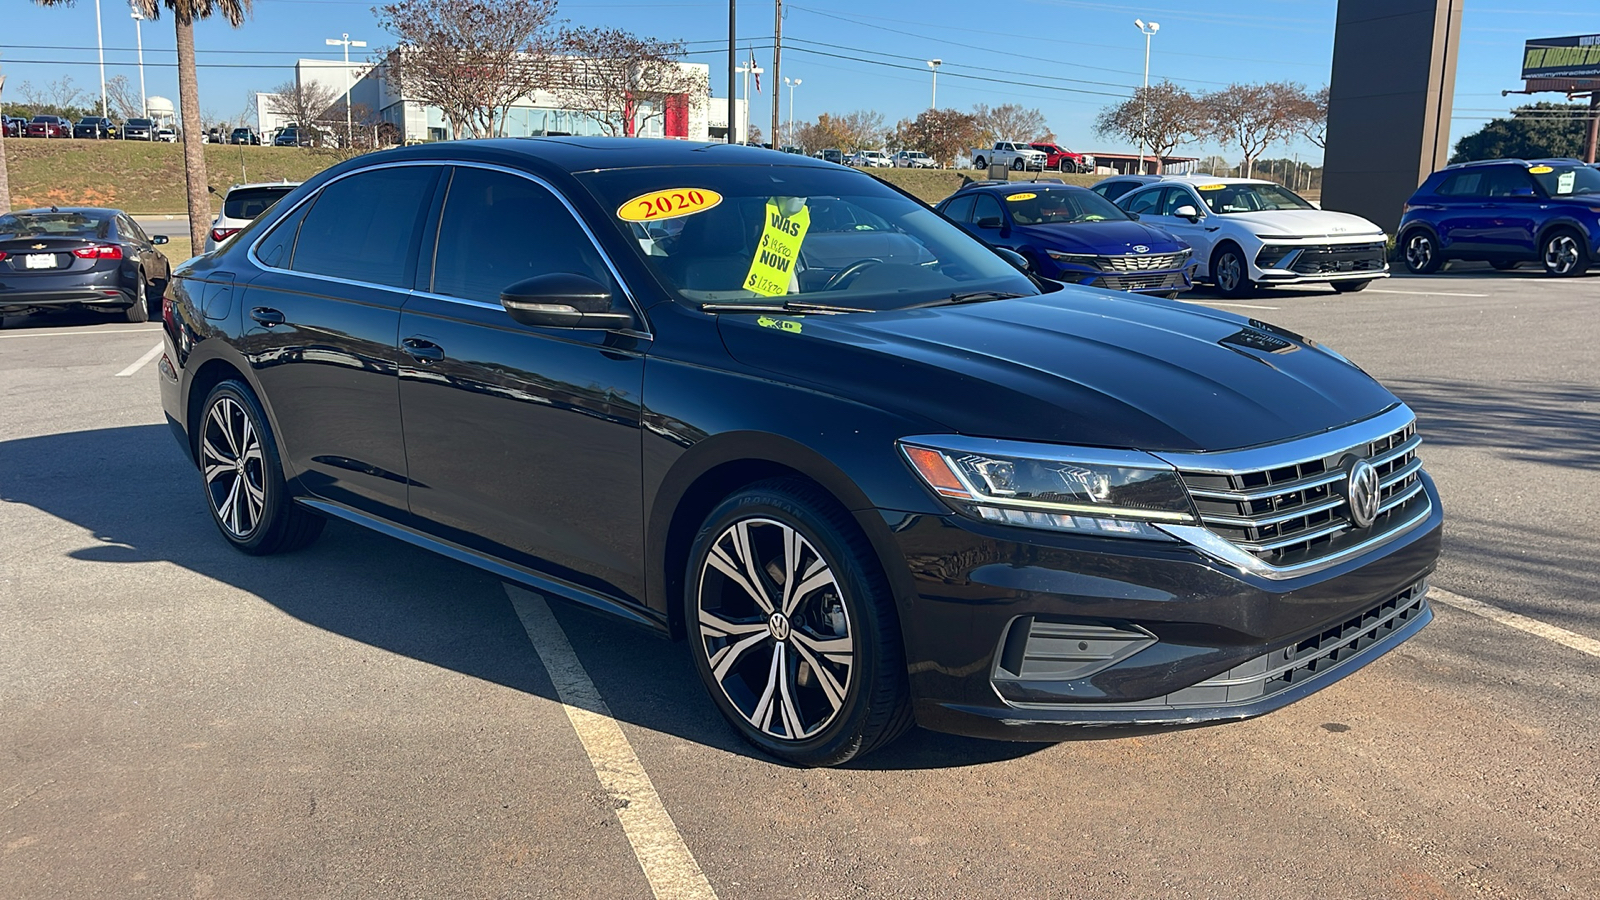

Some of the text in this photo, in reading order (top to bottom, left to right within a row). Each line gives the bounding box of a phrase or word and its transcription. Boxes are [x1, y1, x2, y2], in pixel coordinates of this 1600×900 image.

[1524, 49, 1546, 69] THE
[1541, 46, 1588, 68] MIRACLE
[639, 191, 704, 218] 2020
[771, 212, 800, 237] WAS
[762, 233, 770, 247] $
[760, 249, 790, 273] NOW
[749, 273, 757, 286] $
[739, 497, 803, 517] IRONMAN
